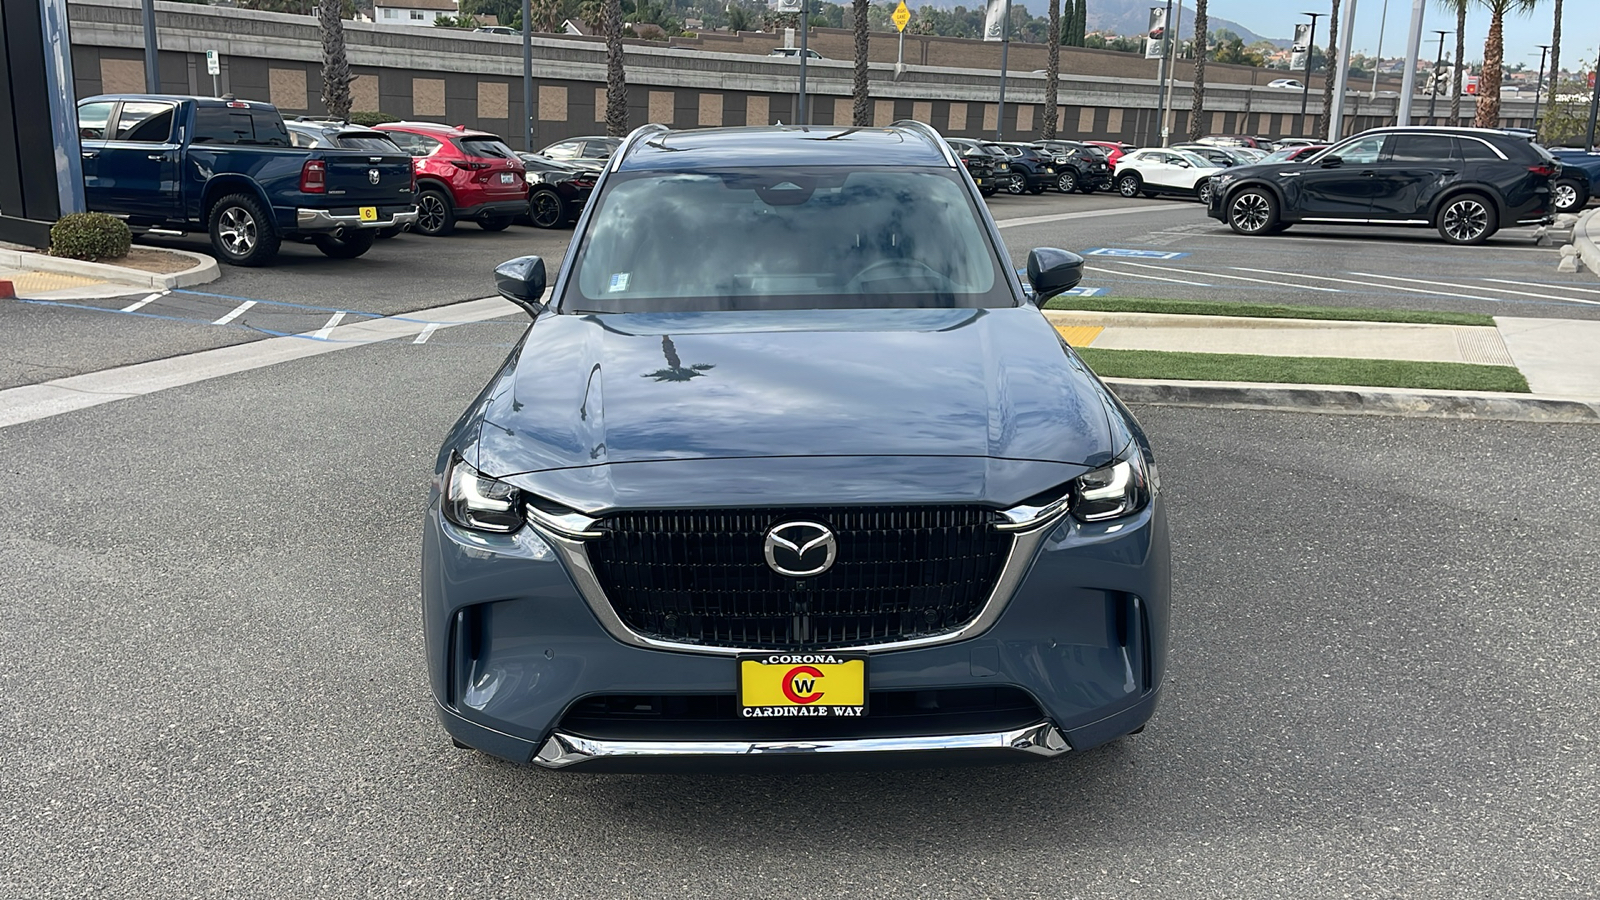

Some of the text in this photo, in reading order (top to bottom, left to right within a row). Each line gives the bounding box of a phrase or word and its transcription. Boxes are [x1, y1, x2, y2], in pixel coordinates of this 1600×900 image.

[768, 655, 836, 664] CORONA
[742, 706, 865, 718] CARDINALE WAY
